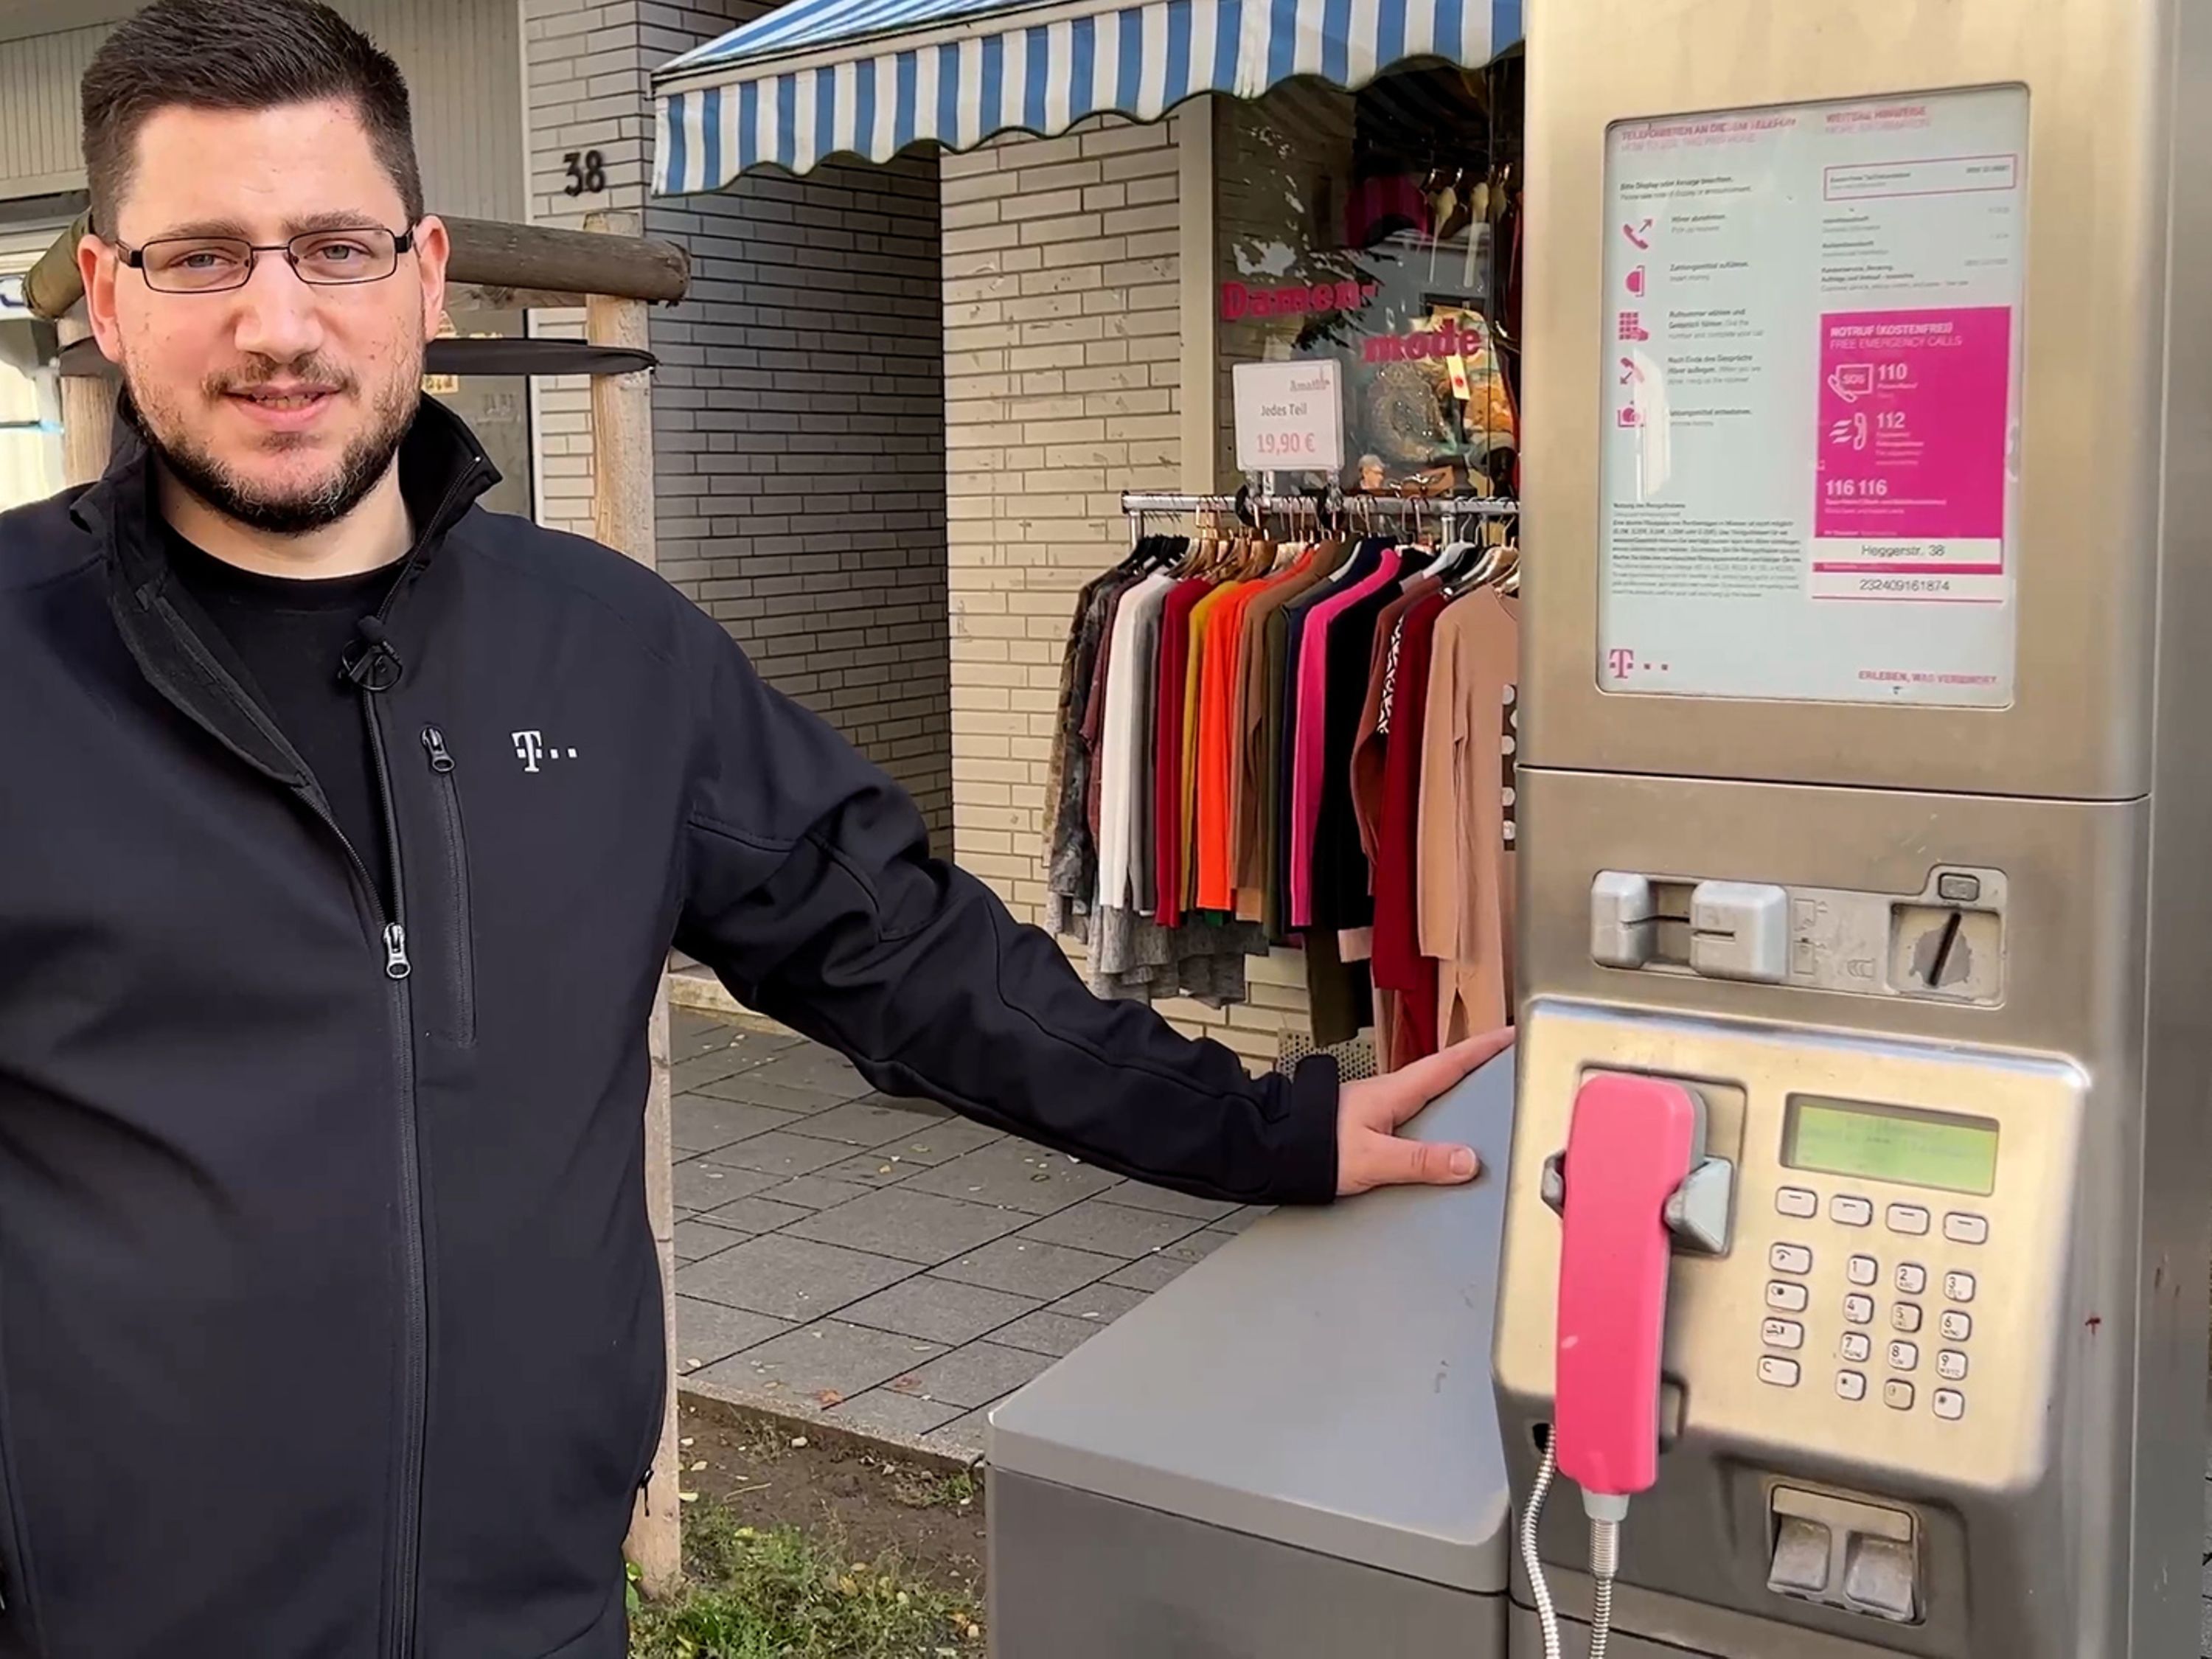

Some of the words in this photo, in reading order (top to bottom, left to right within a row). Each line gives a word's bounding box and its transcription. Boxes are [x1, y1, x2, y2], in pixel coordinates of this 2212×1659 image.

[563, 150, 606, 197] 38
[1221, 281, 1379, 320] Damen-
[1830, 324, 1875, 337] NOTRUF
[1363, 319, 1482, 362] mode
[1830, 338, 1857, 350] FREE
[1858, 335, 1925, 349] EMERGENCY
[1926, 334, 1963, 347] CALLS
[1877, 363, 1908, 381] 110
[1260, 403, 1287, 417] Jedes
[1288, 401, 1308, 417] Teil
[1877, 411, 1906, 429] 112
[1256, 432, 1301, 456] 19,90
[1304, 431, 1316, 453] €
[1825, 479, 1855, 496] 116
[1858, 479, 1888, 496] 116
[1927, 544, 1946, 557] 38
[1859, 579, 1950, 591] 232409161874
[1899, 1268, 1908, 1281] 2
[1948, 1276, 1957, 1290] 3
[1846, 1298, 1855, 1311] 4
[1895, 1307, 1904, 1319] 5
[1943, 1315, 1953, 1328] 6
[1845, 1336, 1853, 1348] 7
[1891, 1345, 1900, 1357] 8
[1762, 1360, 1772, 1374] C
[1941, 1354, 1950, 1366] 9
